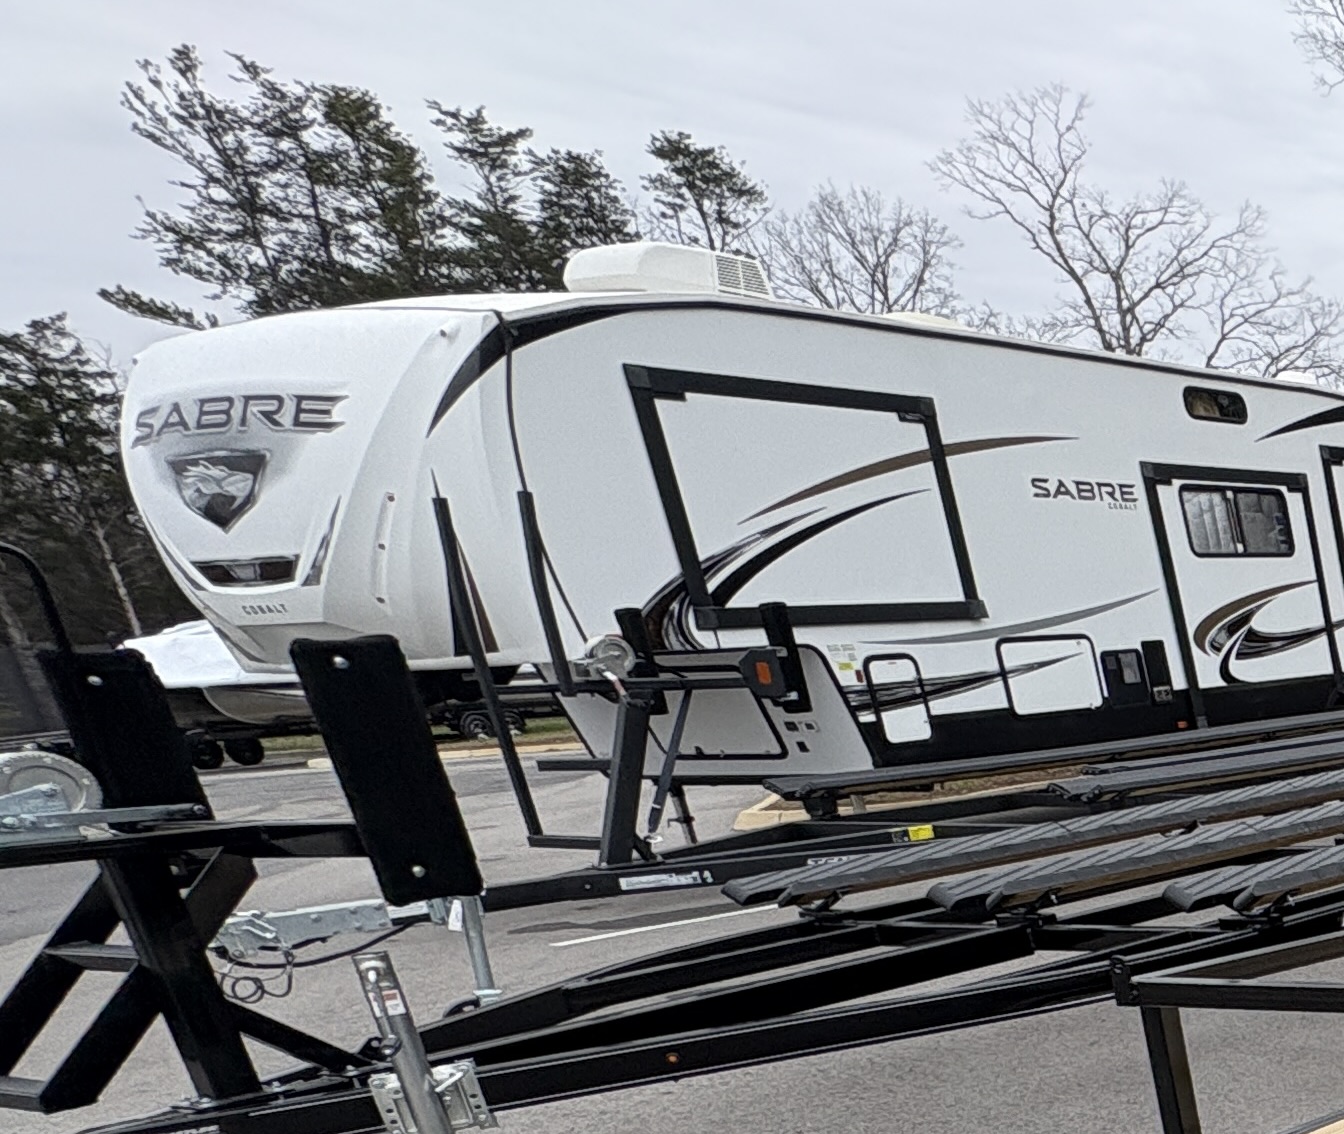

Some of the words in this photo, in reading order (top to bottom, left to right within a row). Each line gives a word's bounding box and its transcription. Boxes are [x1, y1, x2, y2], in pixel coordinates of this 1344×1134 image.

[131, 394, 350, 449] SABRE
[1030, 478, 1139, 503] SABRE
[241, 603, 289, 616] COBALT
